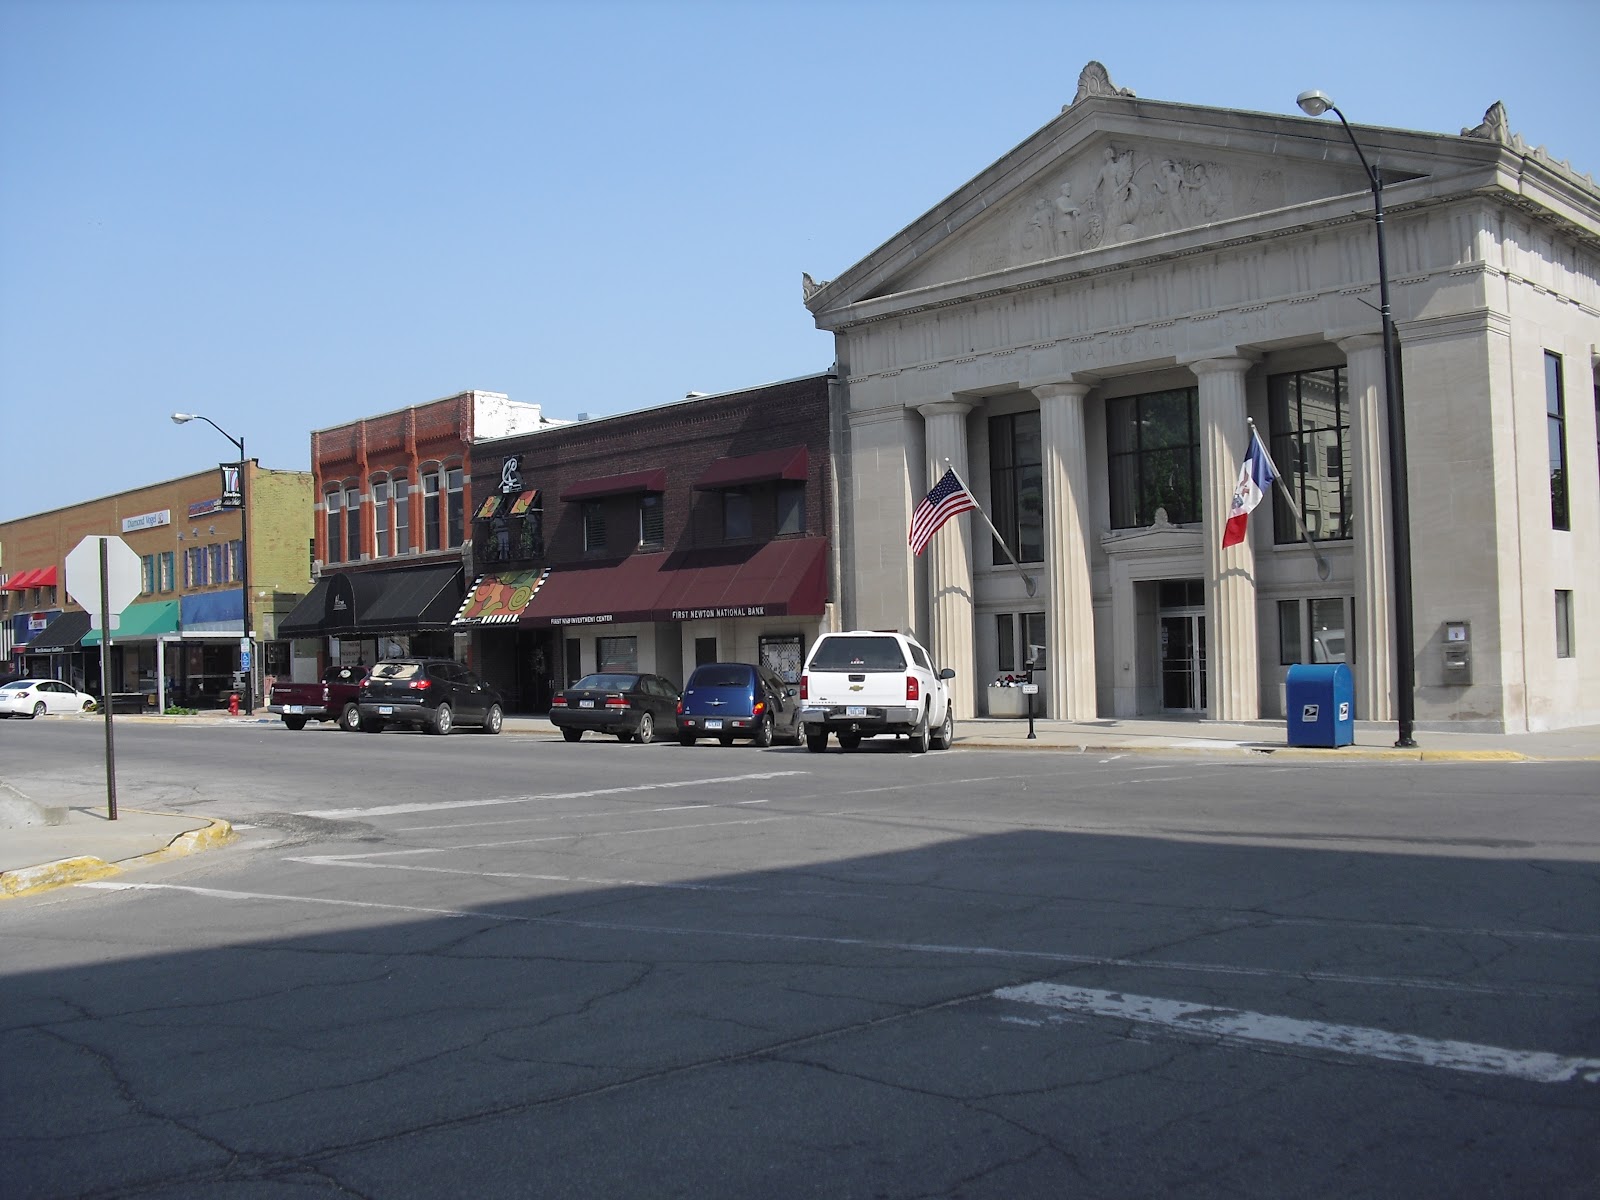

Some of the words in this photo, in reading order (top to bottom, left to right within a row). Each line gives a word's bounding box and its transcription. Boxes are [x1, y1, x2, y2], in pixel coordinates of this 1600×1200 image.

[1071, 333, 1176, 361] NATIONAL
[1224, 310, 1286, 337] BANK
[127, 516, 145, 529] Diamond
[146, 514, 157, 526] Vogel
[571, 616, 596, 624] INVESTMENT
[596, 614, 613, 623] CENTER
[672, 610, 689, 619] FIRST
[690, 609, 715, 619] NEWTON
[716, 608, 746, 618] NATIONAL
[747, 606, 765, 616] BANK
